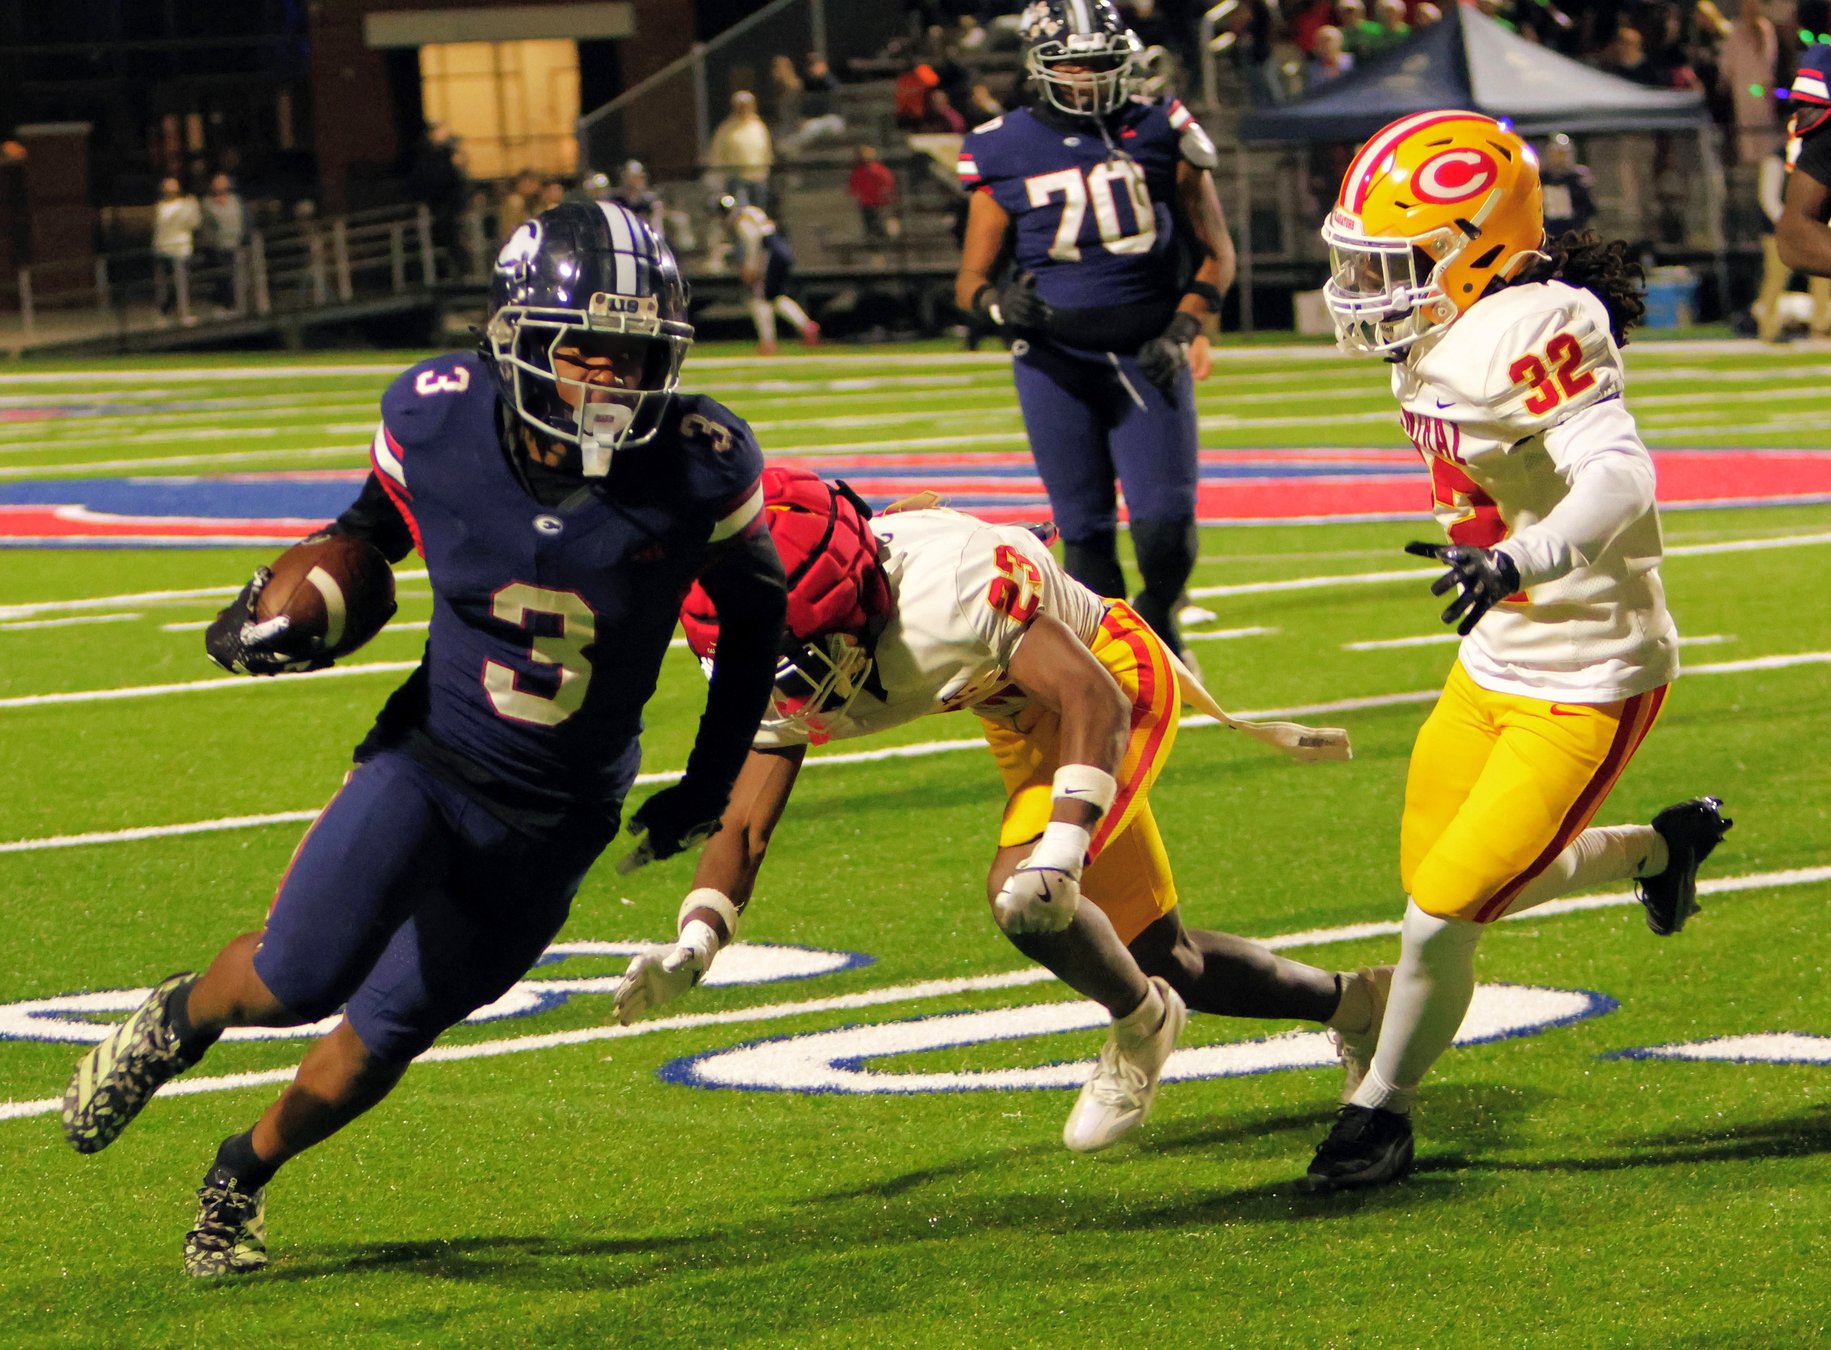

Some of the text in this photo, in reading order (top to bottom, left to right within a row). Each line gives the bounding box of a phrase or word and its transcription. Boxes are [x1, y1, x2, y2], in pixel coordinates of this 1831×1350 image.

[1024, 160, 1157, 262] 70
[1416, 149, 1491, 200] C
[415, 366, 470, 395] 3
[1508, 333, 1596, 416] 32
[681, 413, 732, 452] 3
[987, 544, 1042, 624] 23
[482, 580, 597, 728] 3
